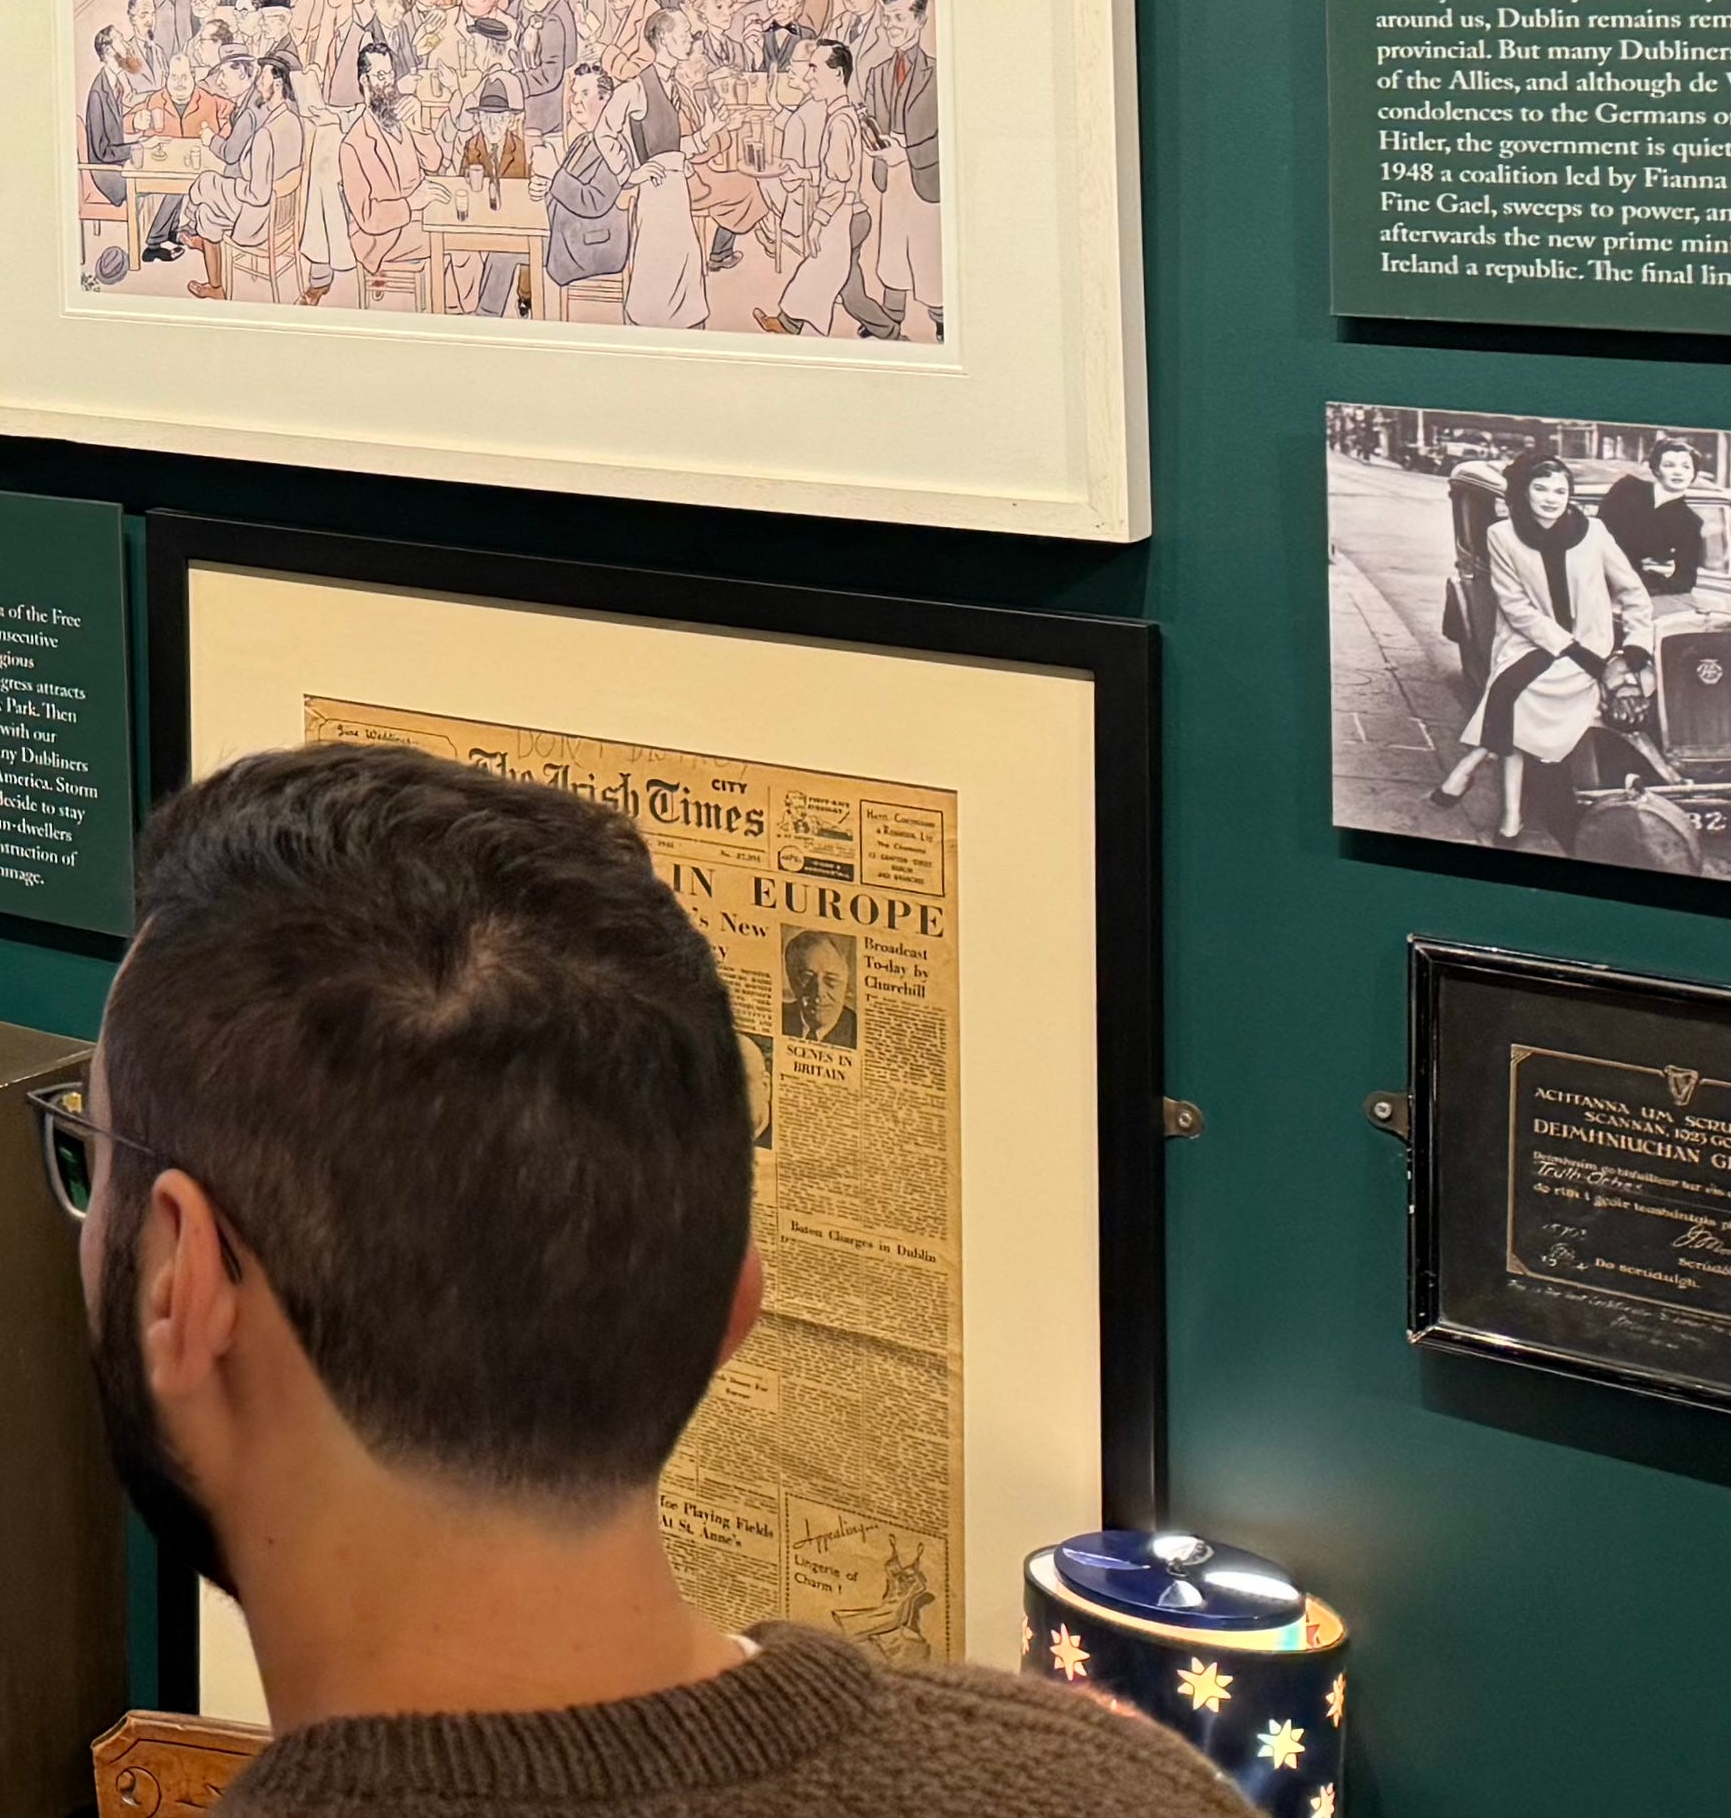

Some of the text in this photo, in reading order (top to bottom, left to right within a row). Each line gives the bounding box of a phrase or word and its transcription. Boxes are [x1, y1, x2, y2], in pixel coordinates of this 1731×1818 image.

[711, 777, 747, 795] CITY
[645, 777, 766, 840] Times
[671, 862, 945, 941] IN EUROPE
[721, 911, 769, 940] New
[864, 936, 928, 961] Broadcast
[864, 955, 929, 983] To-day by
[864, 975, 925, 998] Churchill
[787, 1046, 852, 1067] SCENES IN
[793, 1061, 846, 1080] BRITAIN
[879, 1240, 891, 1253] in
[896, 1243, 937, 1264] Dublin
[683, 1500, 731, 1530] Playing
[736, 1516, 774, 1540] Fields
[846, 1569, 859, 1584] of
